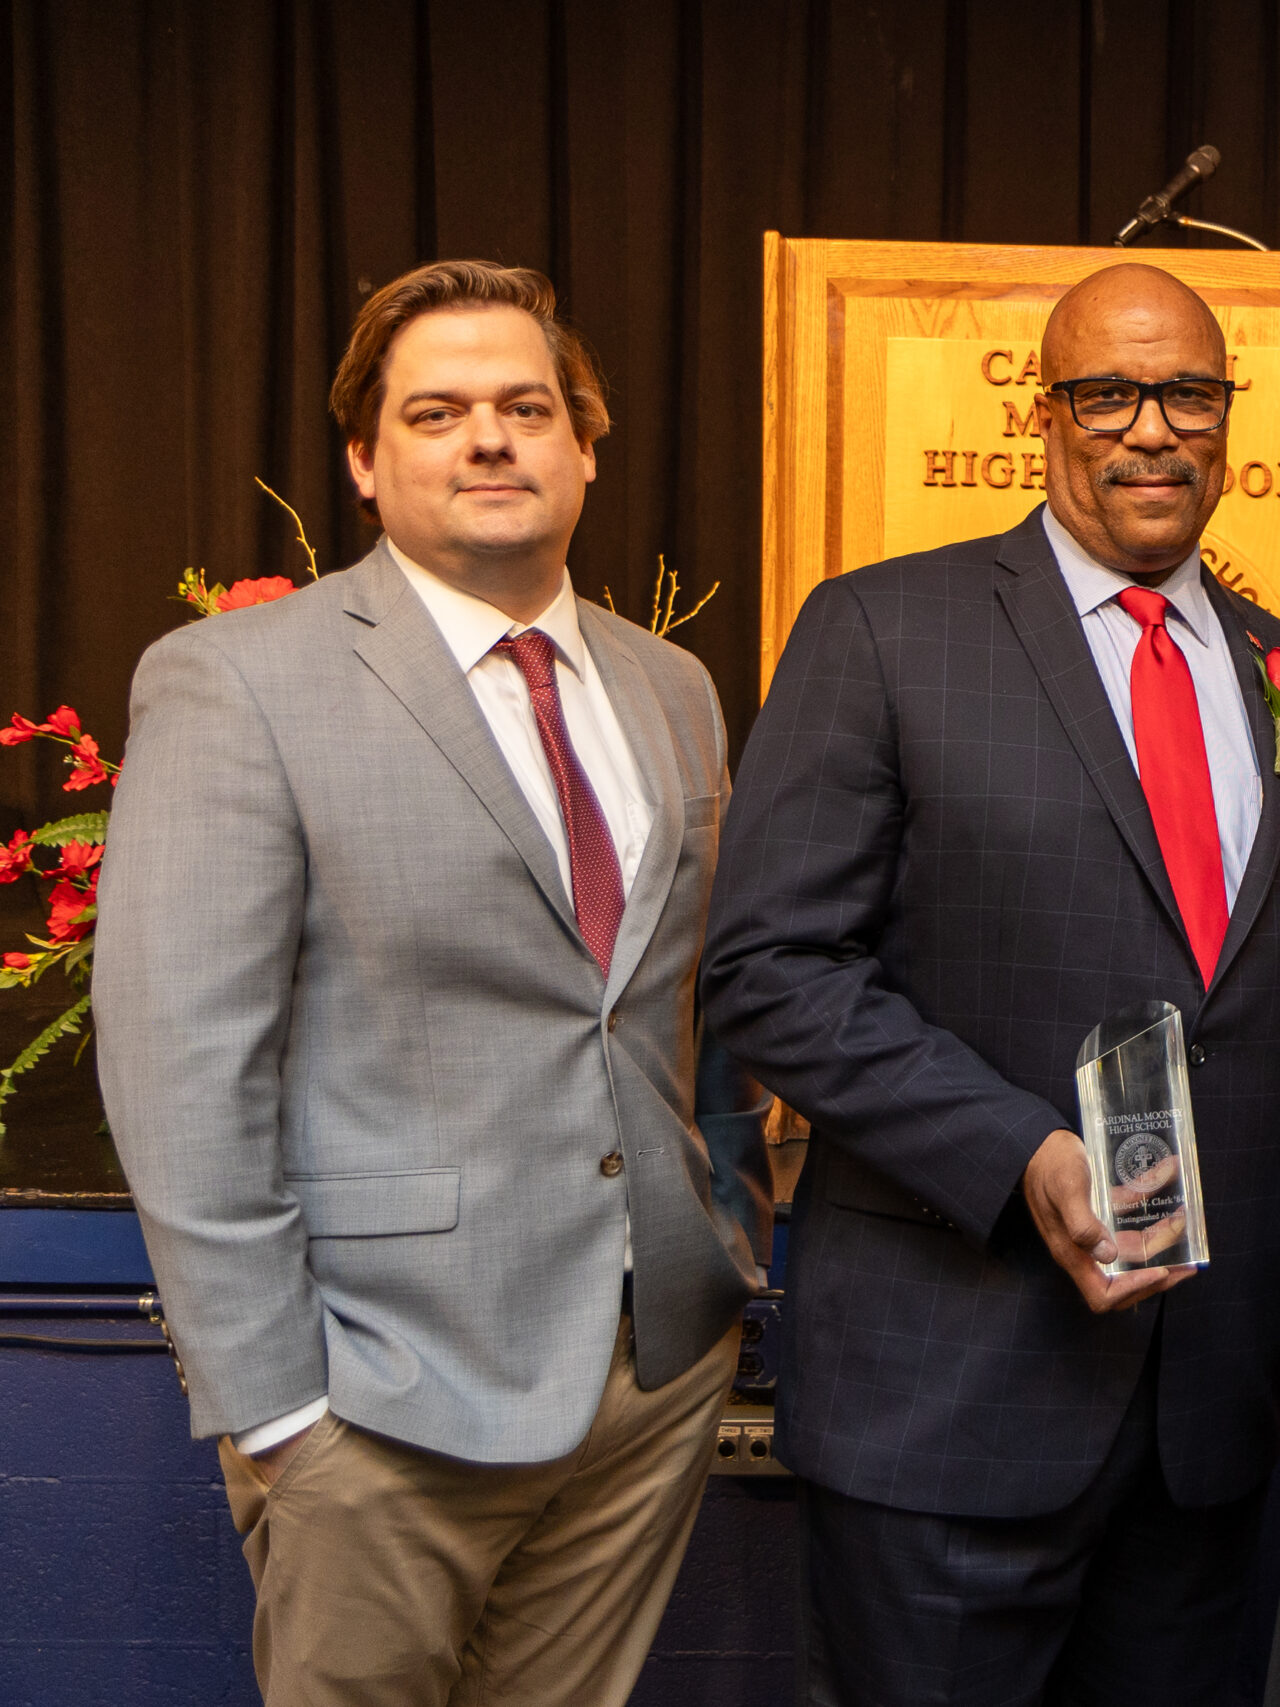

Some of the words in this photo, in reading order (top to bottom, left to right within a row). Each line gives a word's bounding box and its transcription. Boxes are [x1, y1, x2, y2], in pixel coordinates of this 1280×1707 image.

[923, 449, 1048, 490] HIGH
[1096, 1112, 1144, 1126] CARDINAL
[1144, 1109, 1183, 1121] MOONEY
[1109, 1125, 1134, 1135] HIGH
[1135, 1120, 1172, 1132] SCHOOL
[1113, 1201, 1139, 1211] Robert
[1140, 1199, 1151, 1208] W.
[1151, 1196, 1174, 1206] Clark
